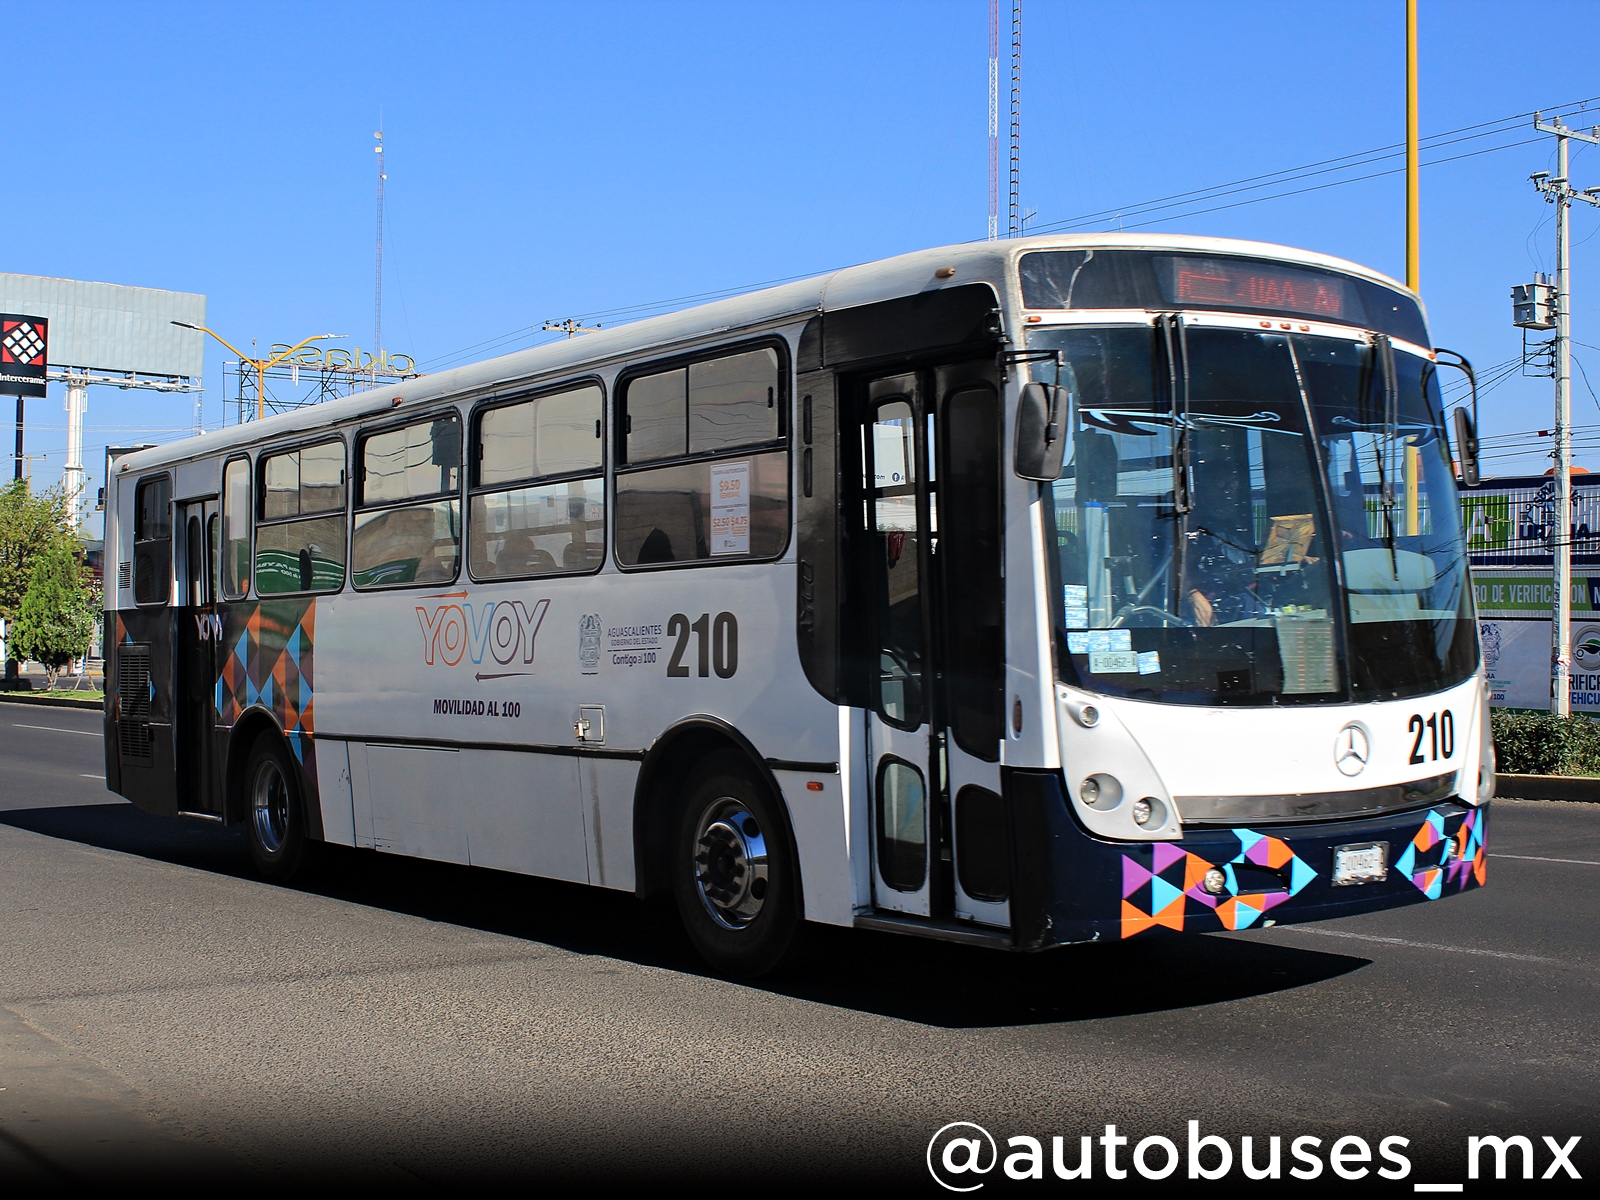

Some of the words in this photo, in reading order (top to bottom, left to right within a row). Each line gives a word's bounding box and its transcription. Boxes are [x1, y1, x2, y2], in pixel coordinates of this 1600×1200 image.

[0, 373, 46, 385] Interceramic
[719, 479, 741, 492] $9.50
[1491, 584, 1504, 603] DE
[415, 598, 551, 667] YOVOY
[607, 625, 662, 637] AGUASCALIENTES
[666, 611, 738, 679] 210
[612, 653, 637, 667] Contigo
[643, 652, 656, 664] 100
[433, 698, 485, 717] MOVILIDAD
[486, 700, 499, 717] AL
[501, 701, 521, 718] 100
[1408, 709, 1455, 765] 210
